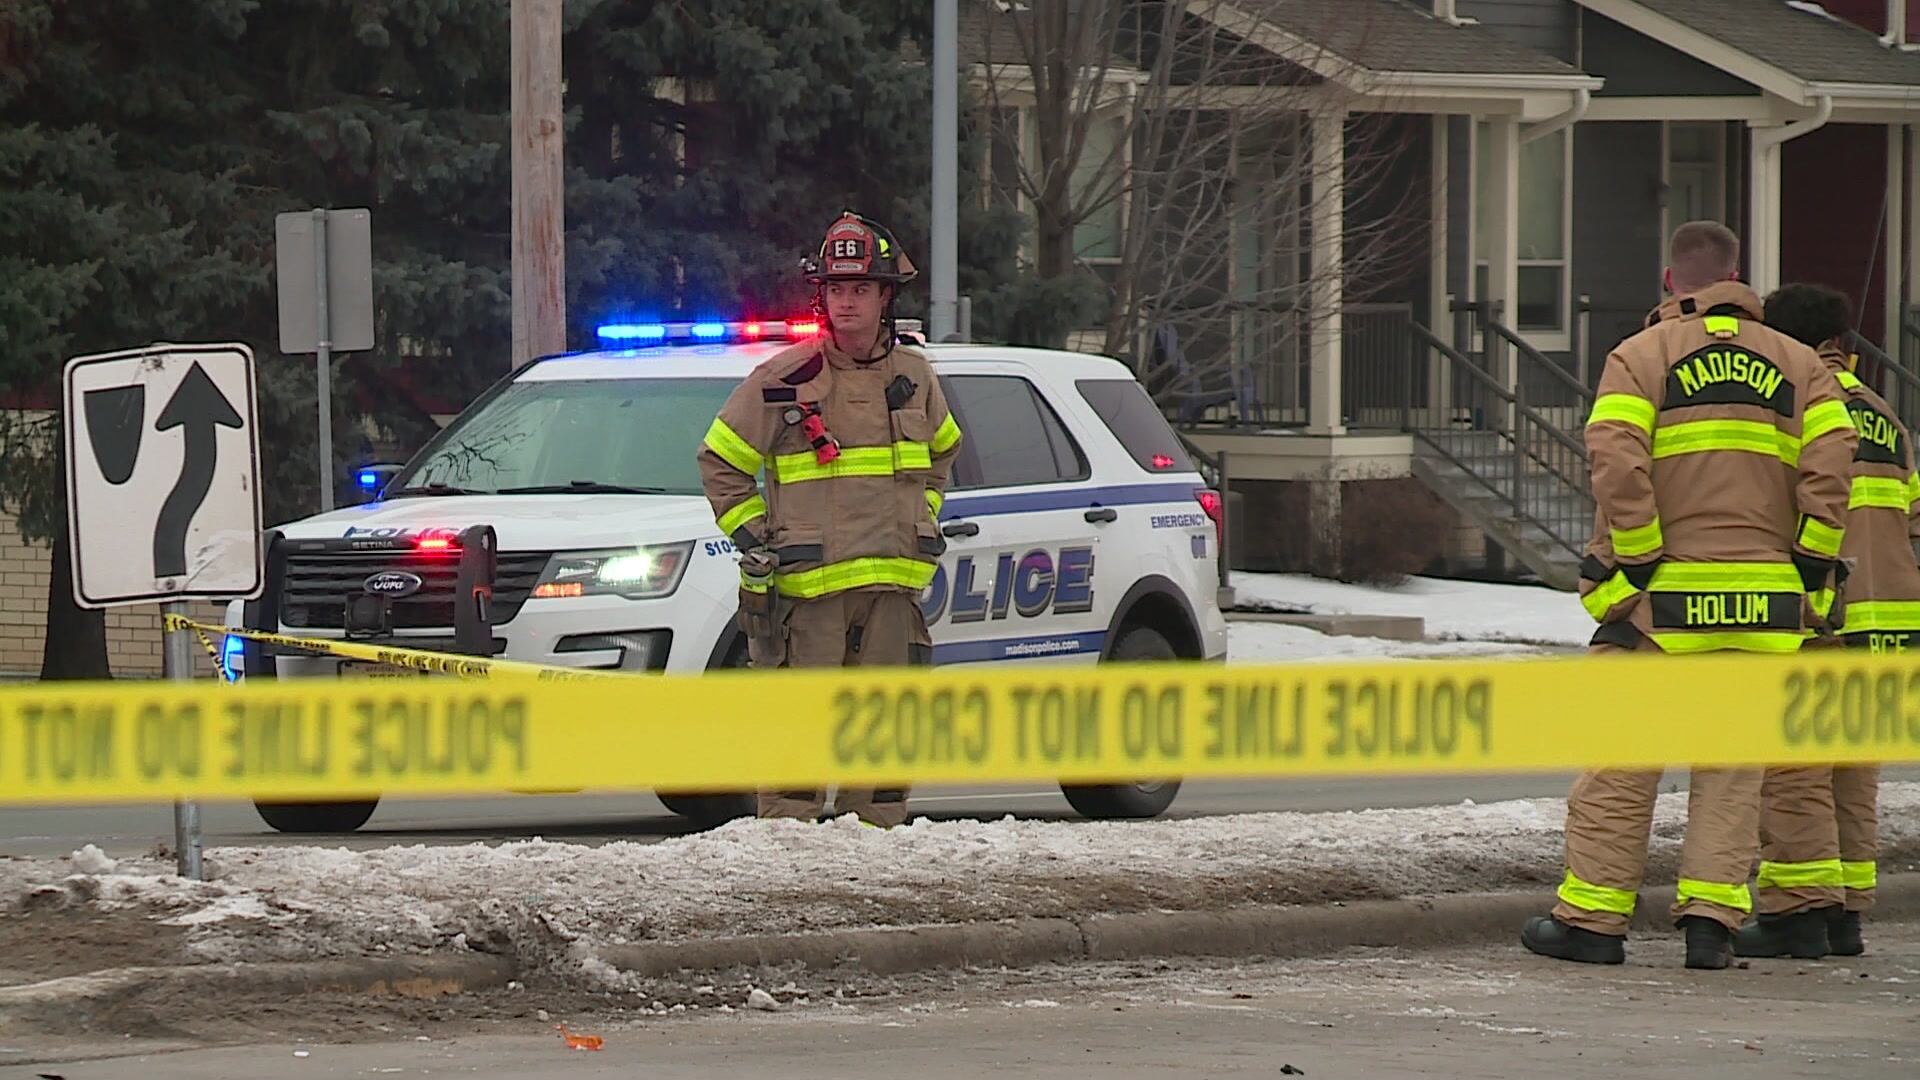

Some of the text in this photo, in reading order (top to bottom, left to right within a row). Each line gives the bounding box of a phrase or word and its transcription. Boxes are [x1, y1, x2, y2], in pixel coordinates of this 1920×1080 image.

[835, 240, 857, 257] E6
[1675, 351, 1784, 400] MADISON
[1151, 514, 1205, 529] EMERGENCY
[351, 540, 394, 549] SETINA
[705, 540, 736, 556] S10
[373, 574, 405, 591] Ford
[920, 545, 1095, 627] OLICE
[1686, 594, 1769, 625] HOLUM
[1005, 640, 1080, 655] madisonpolice.com
